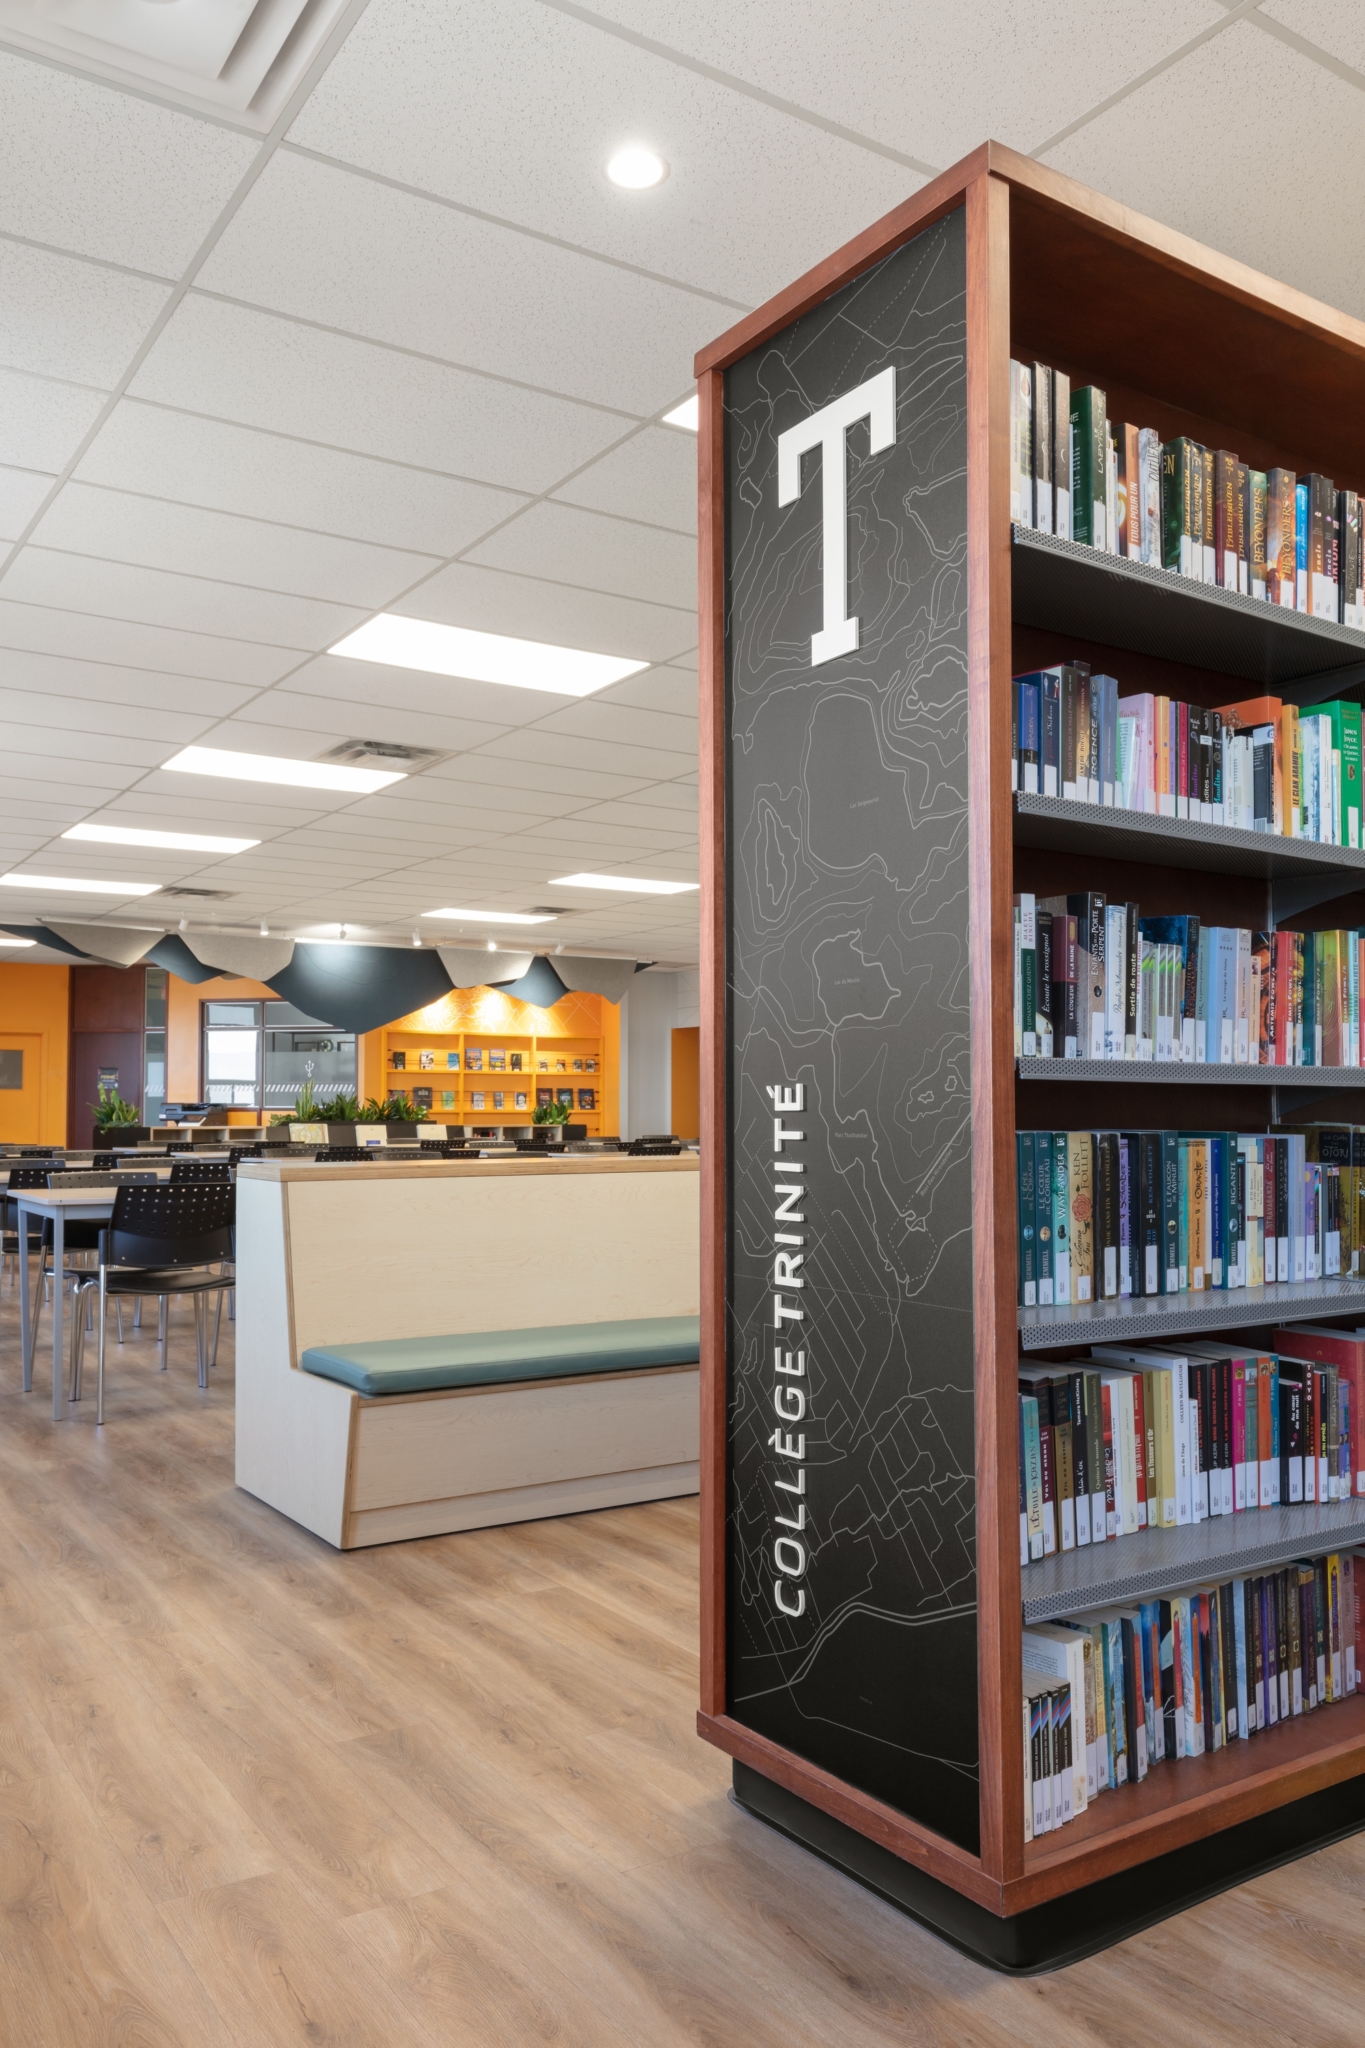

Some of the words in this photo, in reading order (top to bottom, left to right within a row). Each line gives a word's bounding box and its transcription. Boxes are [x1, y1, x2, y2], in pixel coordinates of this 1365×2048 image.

[1130, 481, 1138, 495] UN
[778, 366, 896, 667] T
[1130, 496, 1138, 520] POUR
[1225, 481, 1234, 548] FABLEHAVEN
[1130, 521, 1139, 543] TOUS
[1252, 487, 1265, 563] BEYONDERS
[1281, 500, 1292, 574] BEYONDERS
[1042, 932, 1050, 971] rossignol
[1042, 973, 1049, 981] le
[1130, 979, 1136, 989] de
[1041, 984, 1050, 1012] Écoute
[1080, 1138, 1089, 1189] FOLLETT
[1058, 1153, 1066, 1219] WAYLANDER
[766, 1084, 804, 1328] TRINITÉ
[1038, 1201, 1045, 1209] LE
[1046, 1206, 1050, 1214] DE
[1166, 1197, 1172, 1208] LE
[1266, 1180, 1274, 1231] STRAVAGANZA
[1291, 1413, 1295, 1421] Au
[1030, 1446, 1038, 1480] KAZAN
[1044, 1471, 1048, 1480] DU
[768, 1346, 805, 1617] COLLÈGE
[1030, 1487, 1040, 1528] L'ÉTOILE
[1292, 1624, 1297, 1637] LE
